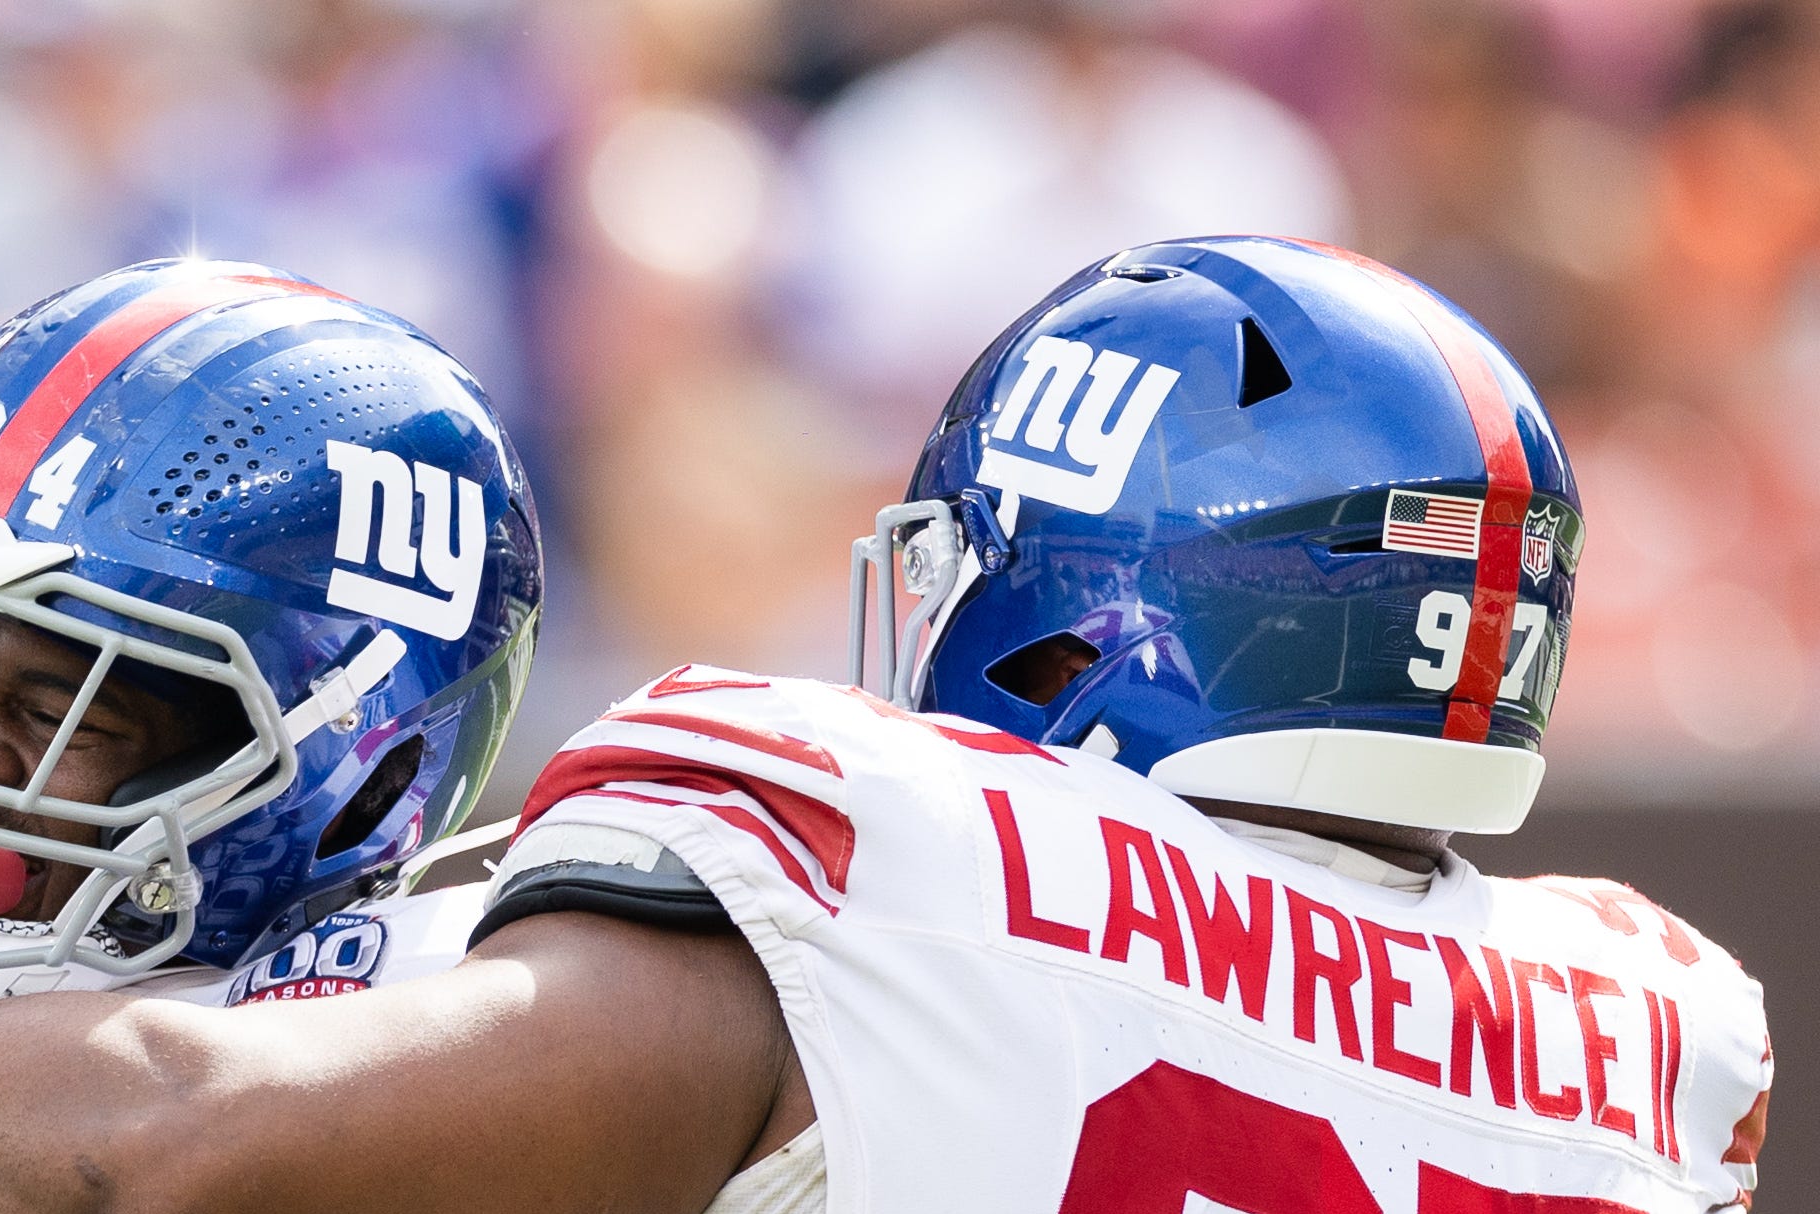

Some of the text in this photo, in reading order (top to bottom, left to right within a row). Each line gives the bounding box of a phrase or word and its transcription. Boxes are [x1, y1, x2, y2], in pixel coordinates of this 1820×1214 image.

[1526, 537, 1550, 571] NFL
[1407, 590, 1548, 700] 97
[981, 787, 1681, 1164] LAWRENCE II
